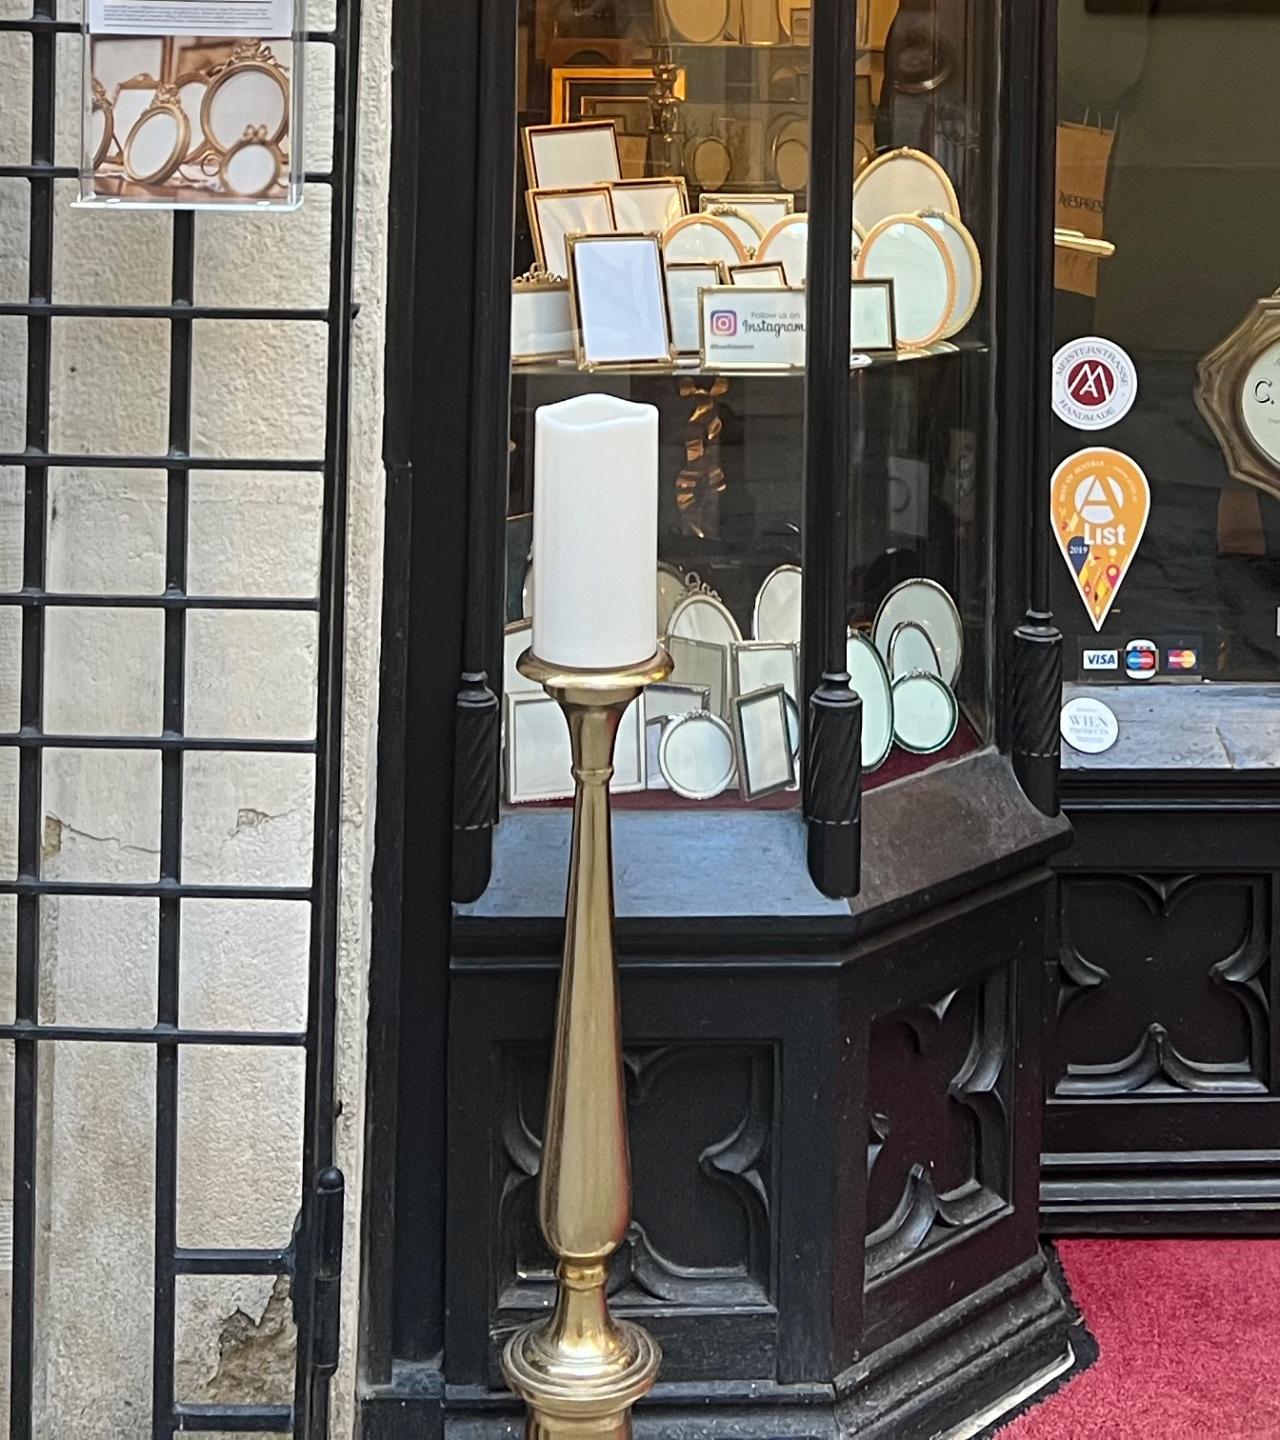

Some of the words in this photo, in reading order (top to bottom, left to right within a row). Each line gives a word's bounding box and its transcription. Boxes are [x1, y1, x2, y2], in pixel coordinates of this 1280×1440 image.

[751, 311, 776, 319] Follow
[742, 319, 806, 337] Instagram
[1056, 347, 1129, 383] MEISTERSTRASSE
[1252, 379, 1275, 406] C.
[1060, 399, 1116, 422] HANDMADE
[1069, 546, 1088, 555] 2019
[1087, 653, 1116, 665] VISA
[1068, 714, 1109, 728] WIEN
